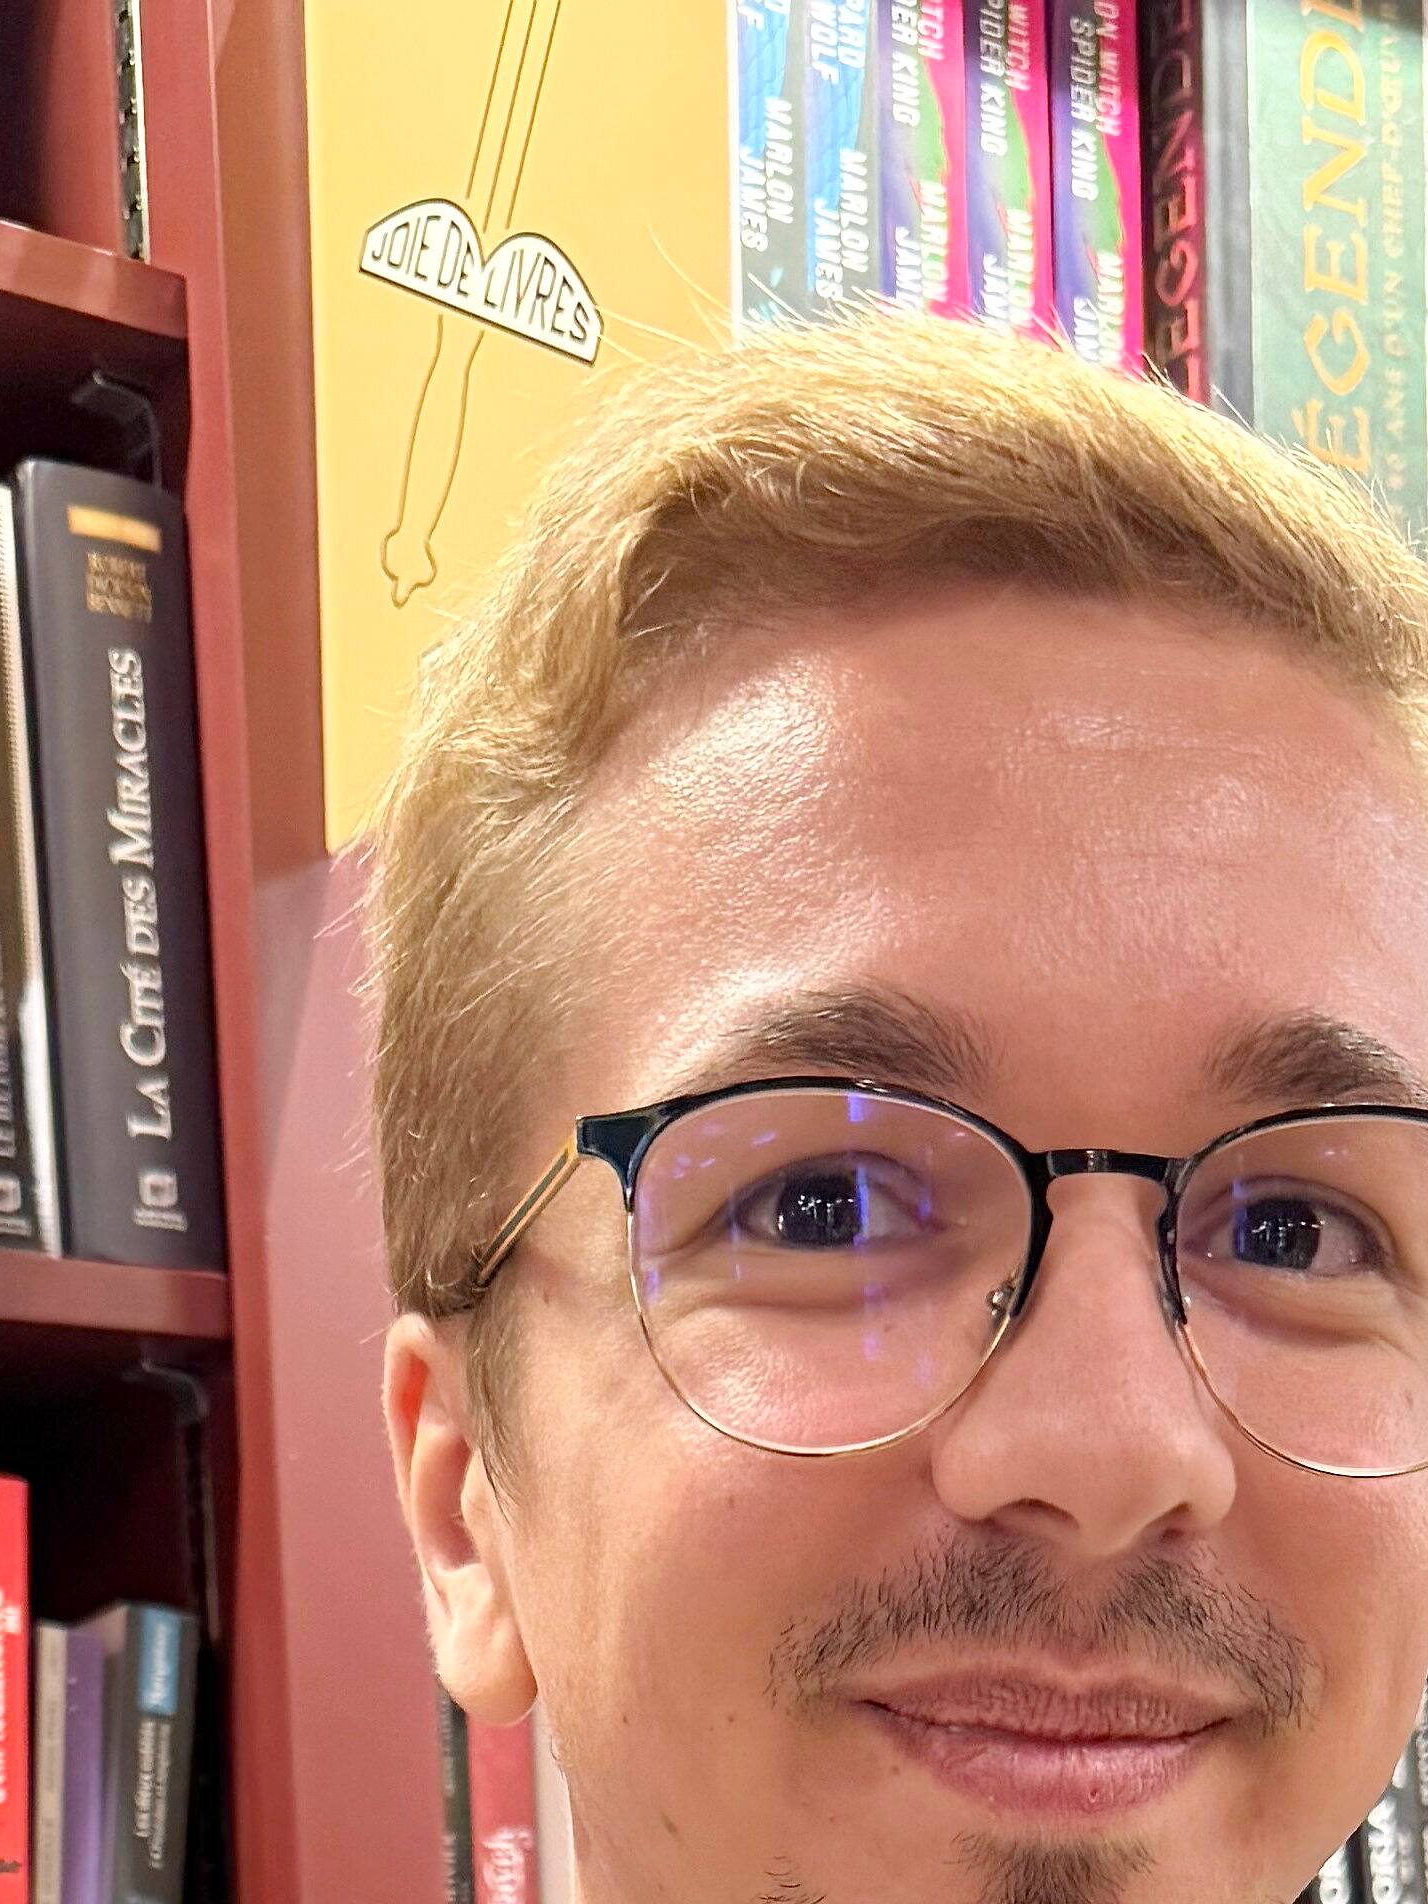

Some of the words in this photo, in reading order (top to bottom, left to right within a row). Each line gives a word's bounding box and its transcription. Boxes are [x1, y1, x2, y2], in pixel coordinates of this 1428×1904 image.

[892, 51, 921, 128] KING
[1005, 3, 1031, 91] WITCH
[1070, 16, 1097, 125] SPIDER
[980, 82, 1008, 157] KING
[1096, 50, 1121, 137] WITCH
[739, 145, 768, 253] JAMES
[765, 97, 794, 224] MARLON
[1071, 129, 1099, 201] KING
[813, 197, 844, 300] JAMES
[839, 148, 869, 273] MARLON
[371, 214, 442, 282] JOIE
[437, 219, 475, 298] DE
[483, 247, 590, 345] LIVRES
[121, 873, 161, 957] DES
[126, 1073, 173, 1142] LA
